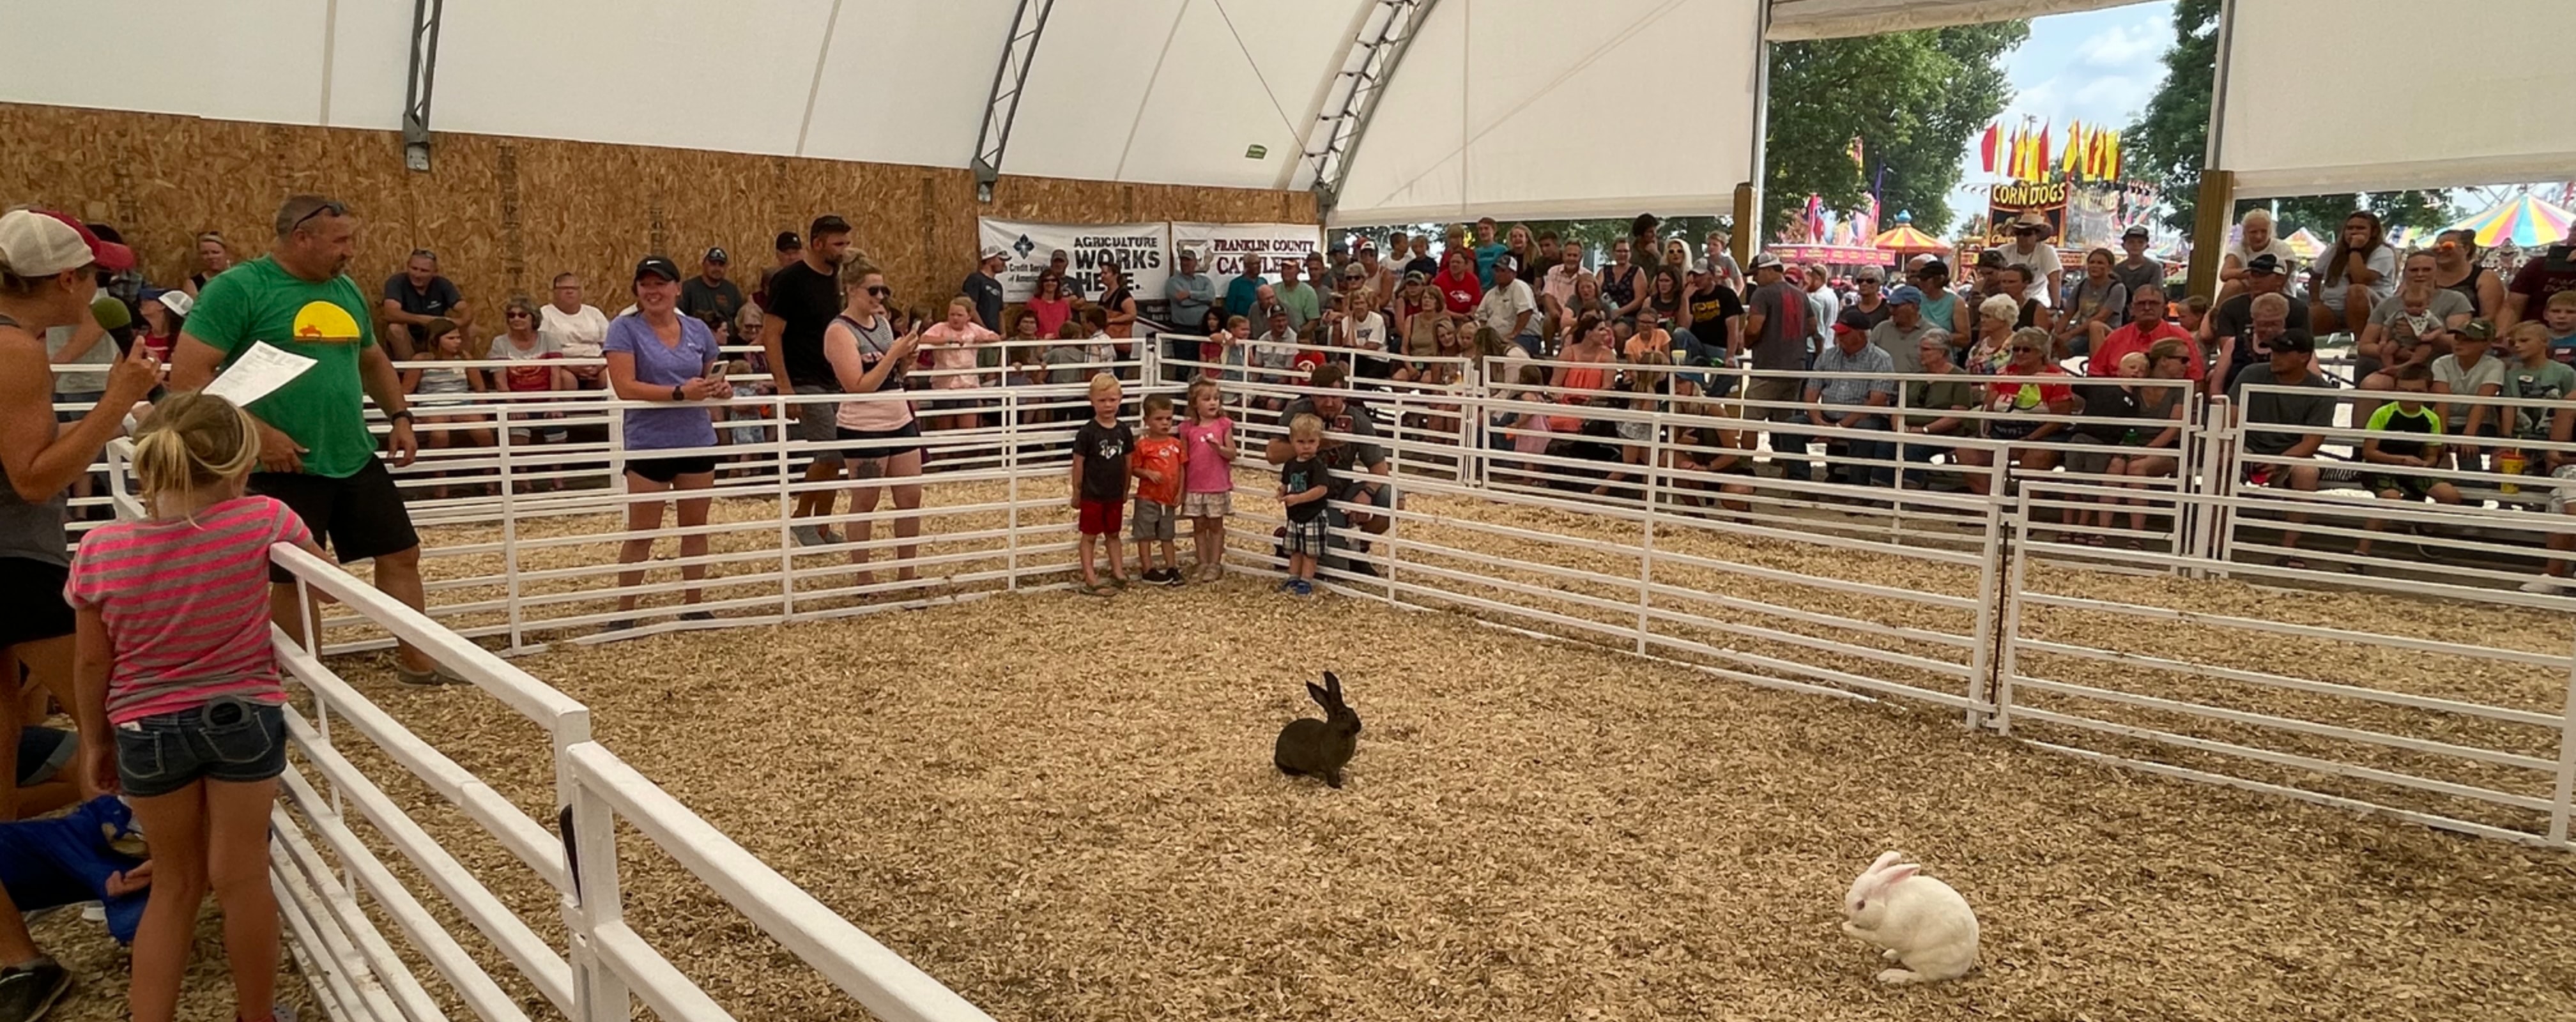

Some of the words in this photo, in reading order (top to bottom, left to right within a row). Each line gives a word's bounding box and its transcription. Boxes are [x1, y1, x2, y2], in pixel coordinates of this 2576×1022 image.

[1993, 185, 2027, 204] CORN
[2029, 182, 2066, 204] DOGS
[1074, 236, 1158, 248] AGRICULTURE
[1214, 239, 1269, 251] FRANKLIN
[1273, 240, 1314, 252] COUNTY
[1009, 263, 1028, 272] Credit
[1074, 248, 1160, 270] WORKS
[1076, 271, 1140, 292] HEE.
